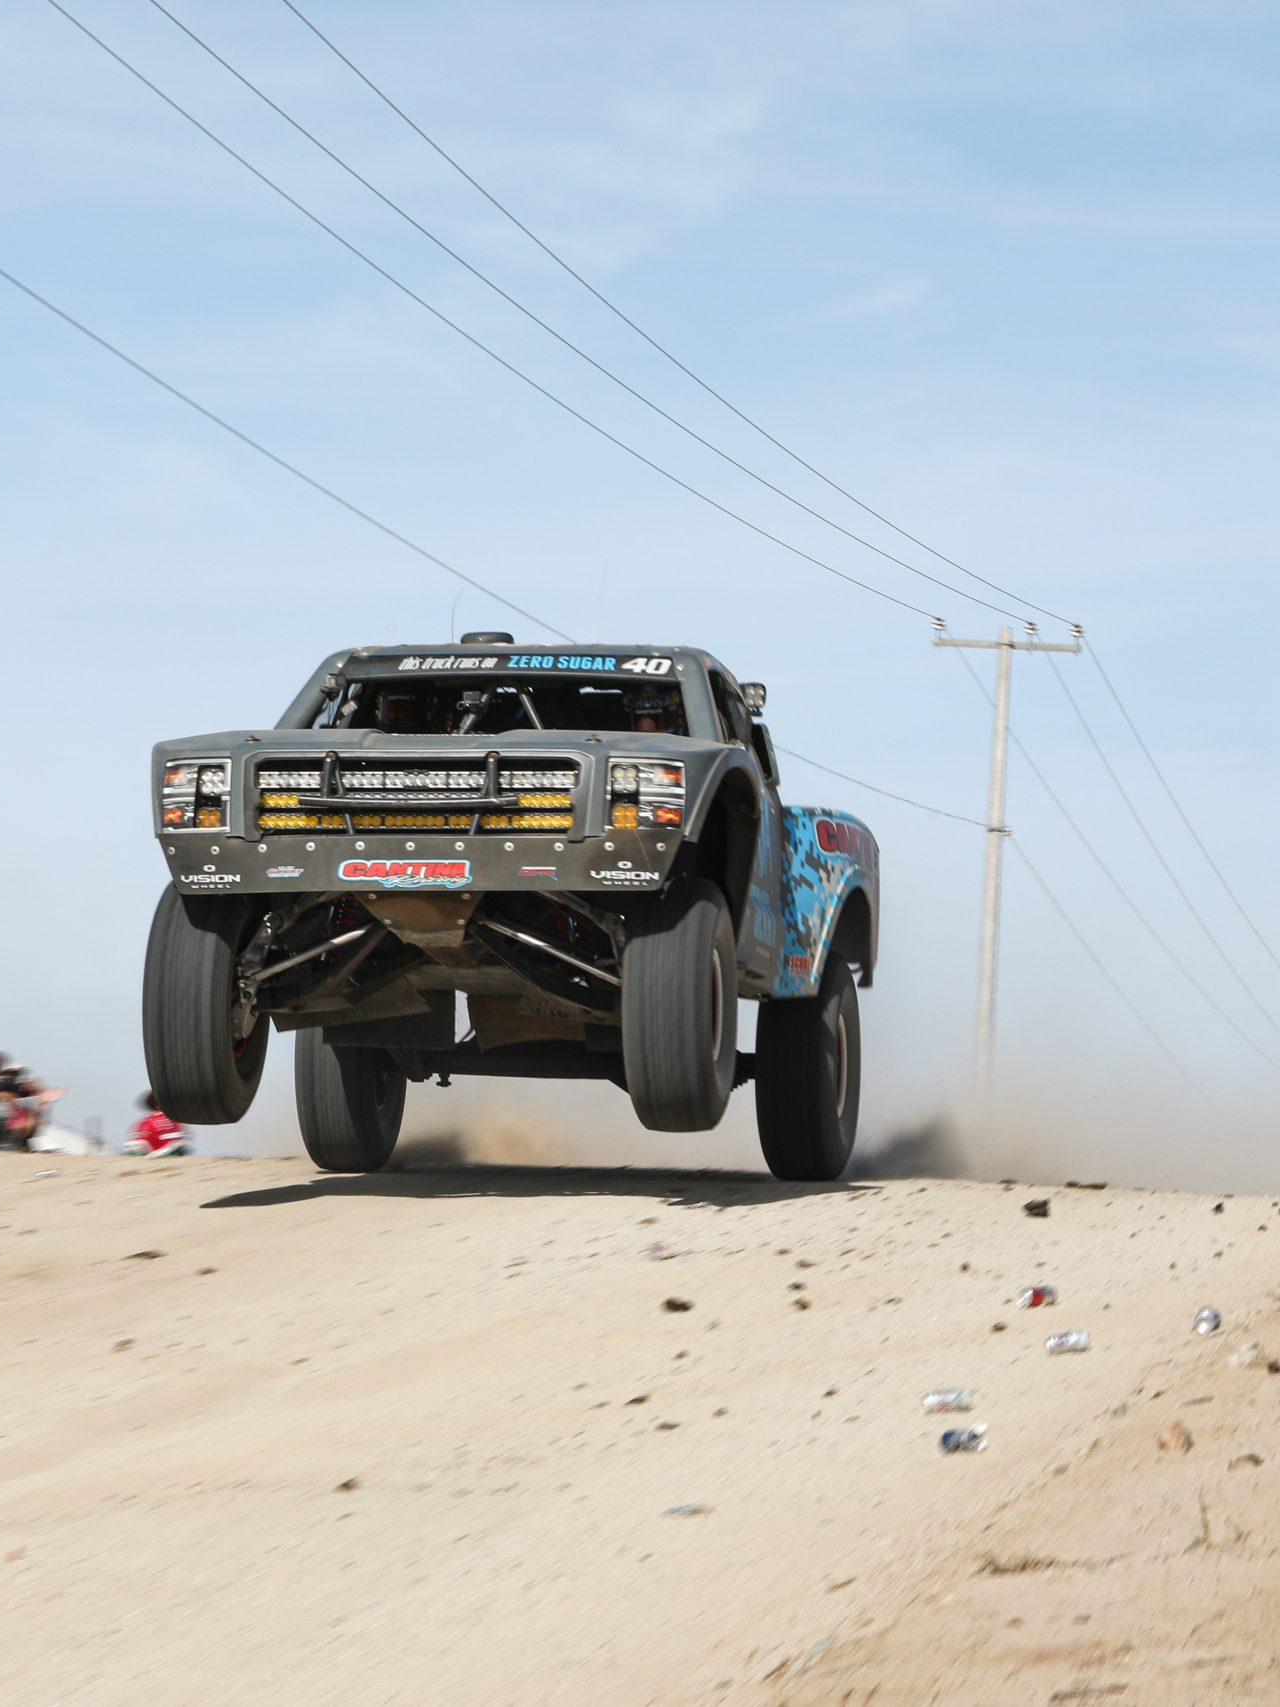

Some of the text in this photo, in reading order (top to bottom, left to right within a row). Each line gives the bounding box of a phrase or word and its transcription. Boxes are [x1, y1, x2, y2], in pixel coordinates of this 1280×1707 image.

[398, 655, 671, 675] this truck runs on ZERO SUGAR 40
[342, 862, 466, 878] CANTINA
[589, 870, 660, 881] VISION
[180, 874, 241, 883] VISION
